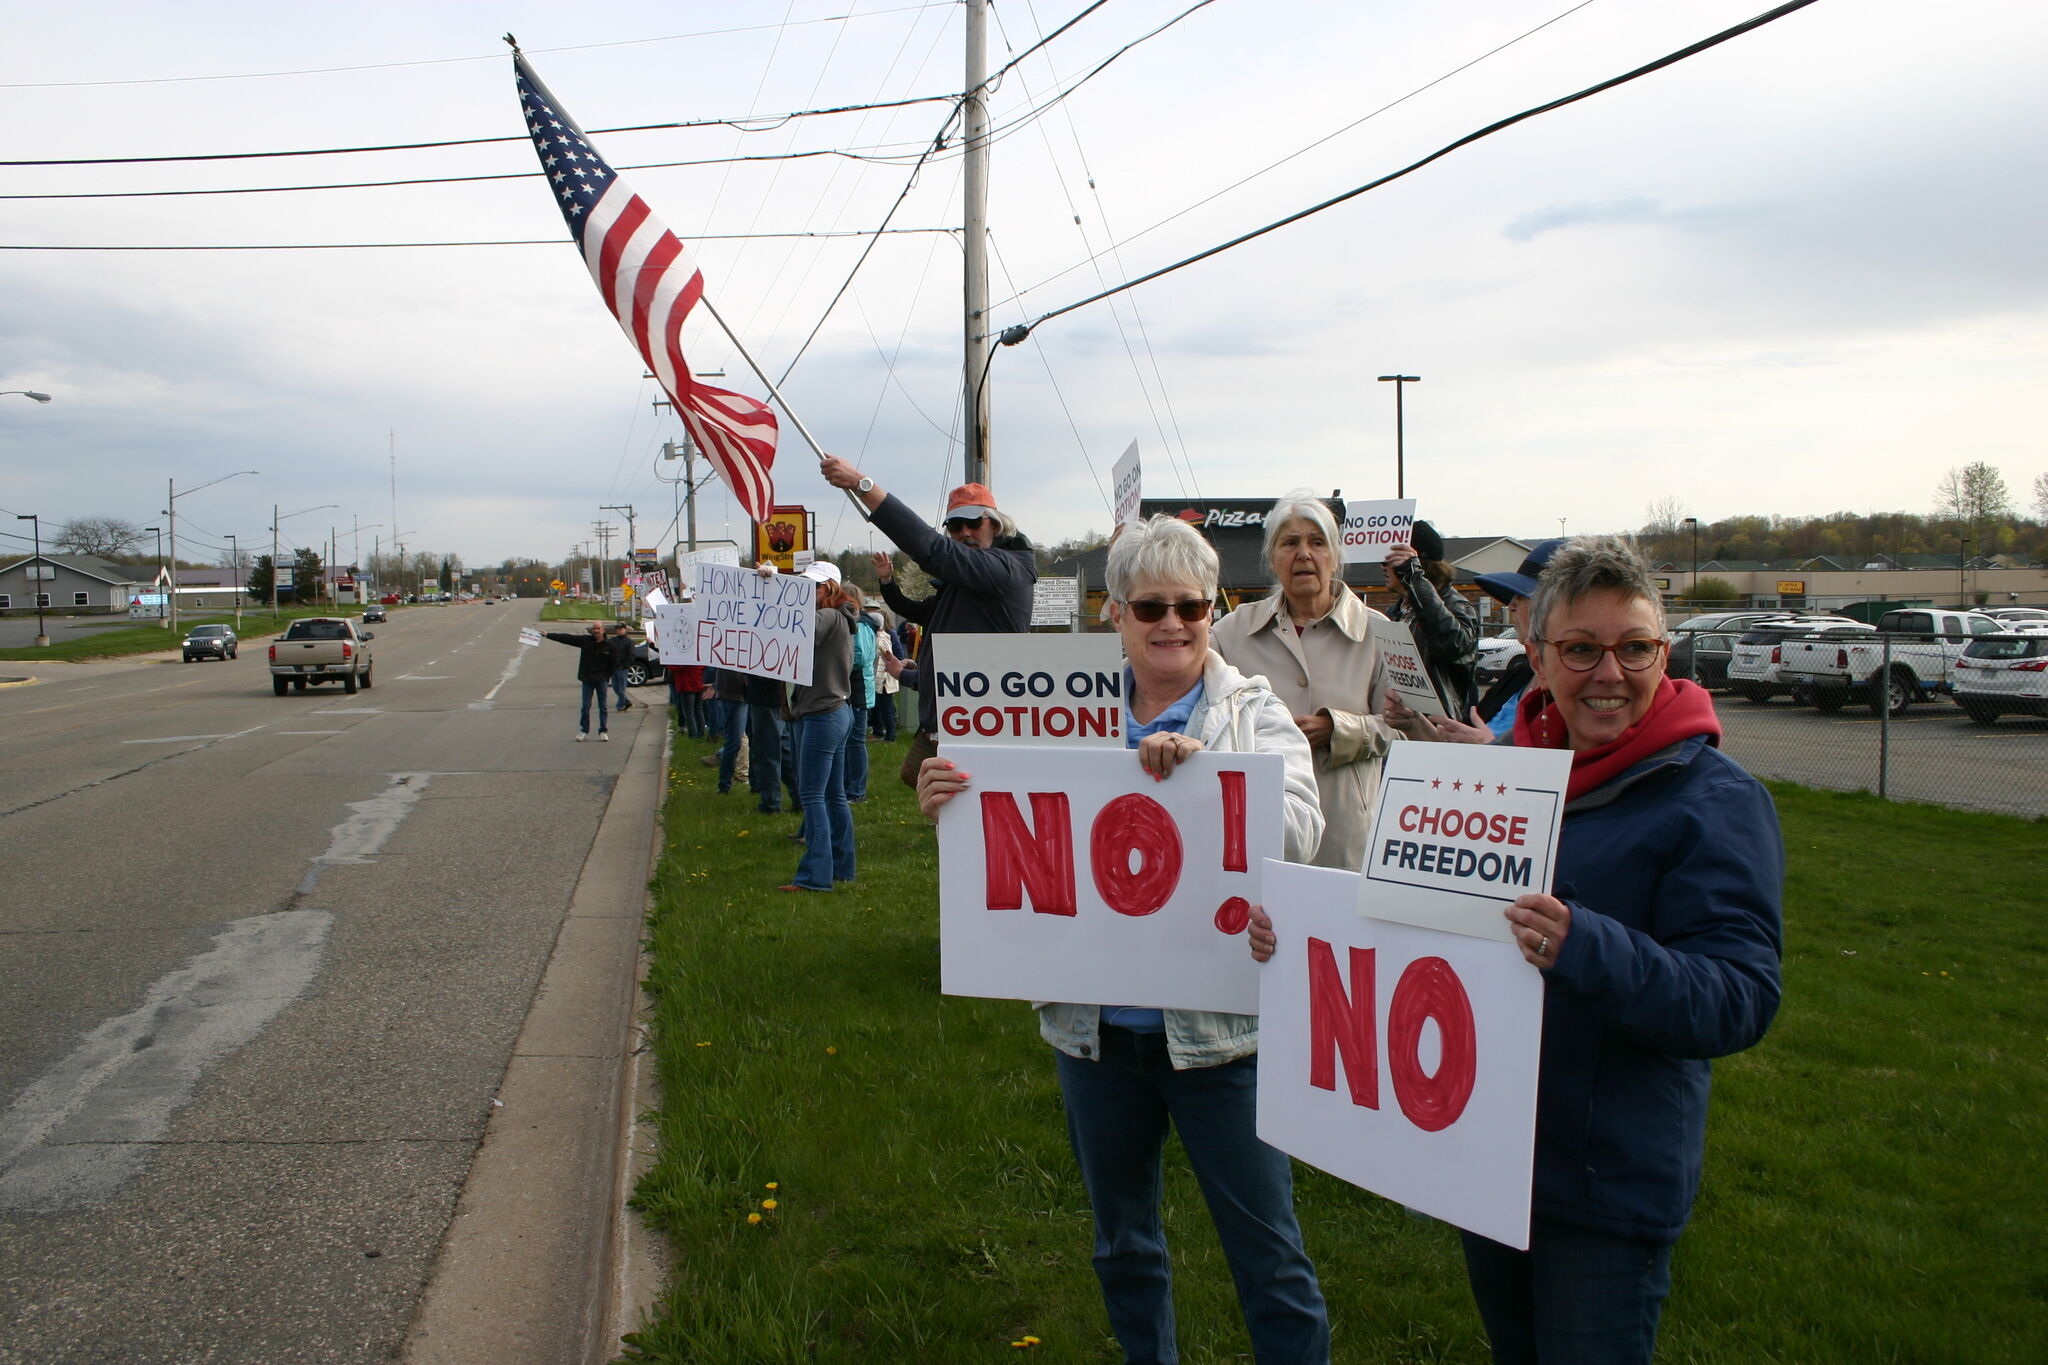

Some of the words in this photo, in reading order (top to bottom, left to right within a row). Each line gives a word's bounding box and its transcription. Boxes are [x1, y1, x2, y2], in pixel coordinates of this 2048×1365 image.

[1122, 473, 1132, 493] GO
[1203, 508, 1262, 528] Pizza
[1344, 517, 1364, 529] NO
[1367, 515, 1388, 528] GO
[1391, 514, 1413, 527] ON
[1344, 530, 1410, 545] GOTION!
[701, 566, 746, 599] HONK
[751, 573, 770, 600] IF
[775, 577, 811, 607] YOU
[706, 599, 746, 625] LOVE
[753, 602, 807, 638] YOUR
[696, 620, 799, 680] FREEDOM
[1384, 651, 1418, 671] CHOOSE
[936, 671, 990, 698] NO
[1000, 671, 1055, 698] GO
[1065, 671, 1121, 698] ON
[1388, 669, 1429, 690] FREEDOM
[941, 706, 1120, 738] GOTION!
[1398, 804, 1529, 846] CHOOSE
[1381, 839, 1533, 887] FREEDOM
[1307, 936, 1477, 1133] NO
